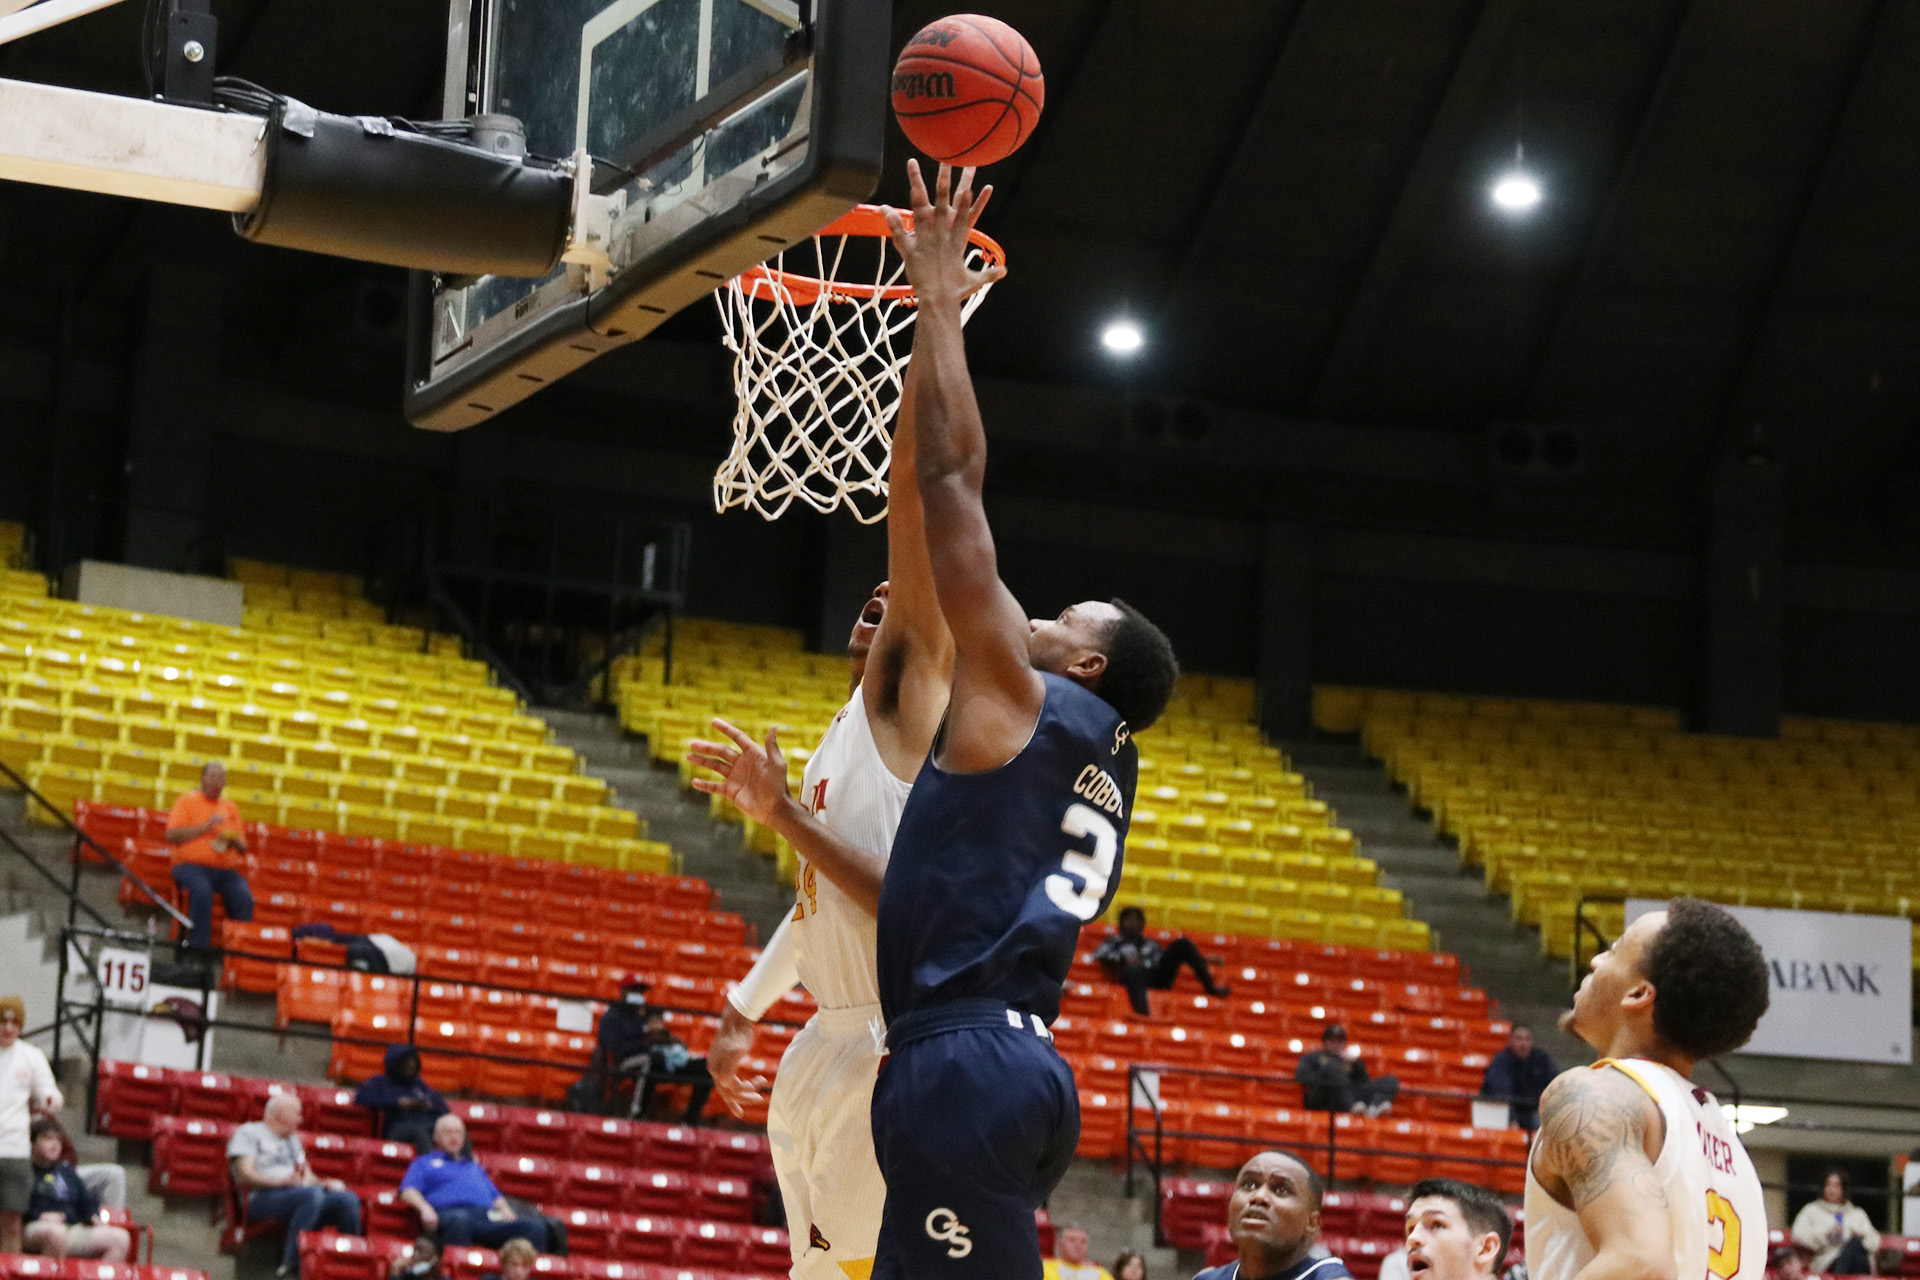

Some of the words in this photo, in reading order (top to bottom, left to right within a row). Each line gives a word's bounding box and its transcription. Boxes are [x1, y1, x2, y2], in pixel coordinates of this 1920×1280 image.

[1045, 803, 1118, 921] 3
[104, 960, 144, 993] 115
[925, 1207, 973, 1258] GS
